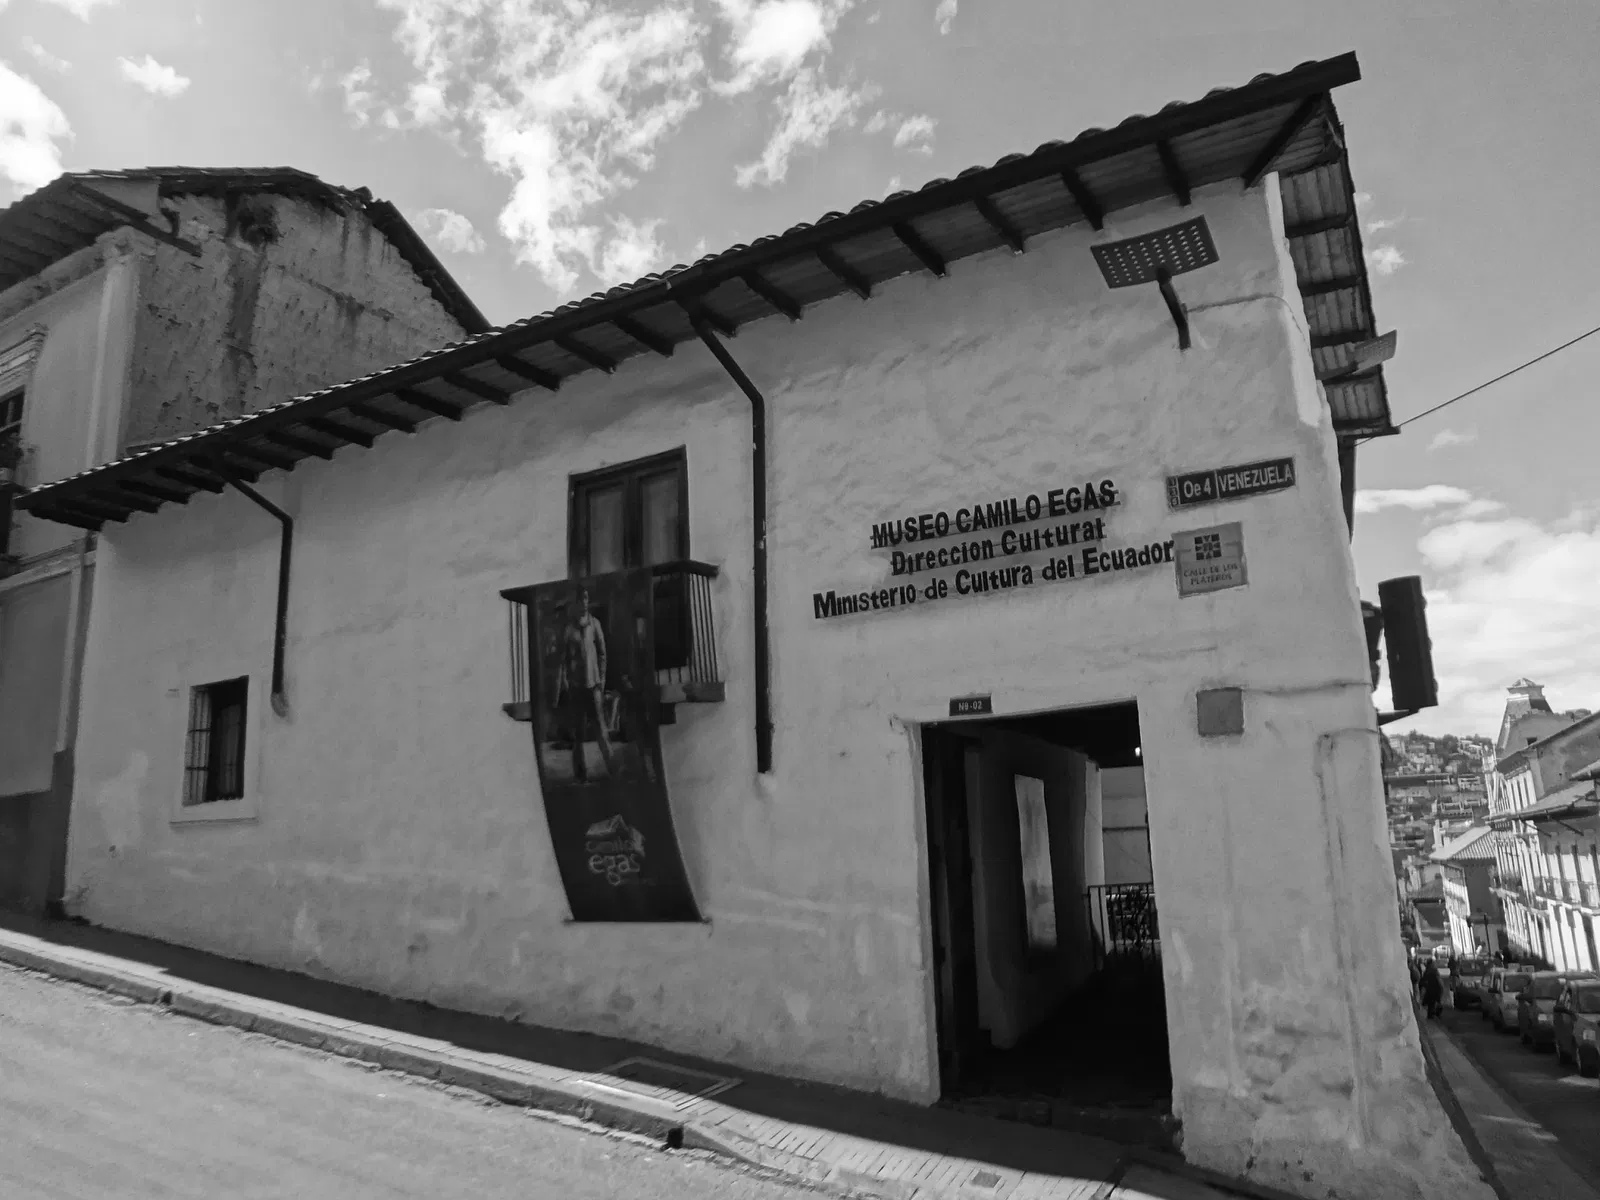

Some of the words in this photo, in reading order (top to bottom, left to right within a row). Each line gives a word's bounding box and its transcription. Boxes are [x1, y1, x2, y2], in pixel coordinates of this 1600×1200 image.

[1183, 480, 1201, 499] Oe
[1203, 477, 1211, 495] 4
[1218, 464, 1293, 492] VENEZUELA
[872, 511, 949, 548] MUSEO
[956, 494, 1041, 532] CAMILO
[1048, 480, 1115, 516] EGAS
[892, 539, 994, 575] Direccion
[1002, 517, 1106, 554] Cultural
[813, 584, 916, 619] Ministerio
[925, 578, 948, 600] de
[956, 565, 1033, 595] Cultura
[1042, 554, 1075, 581] del
[1082, 539, 1174, 575] Ecuador
